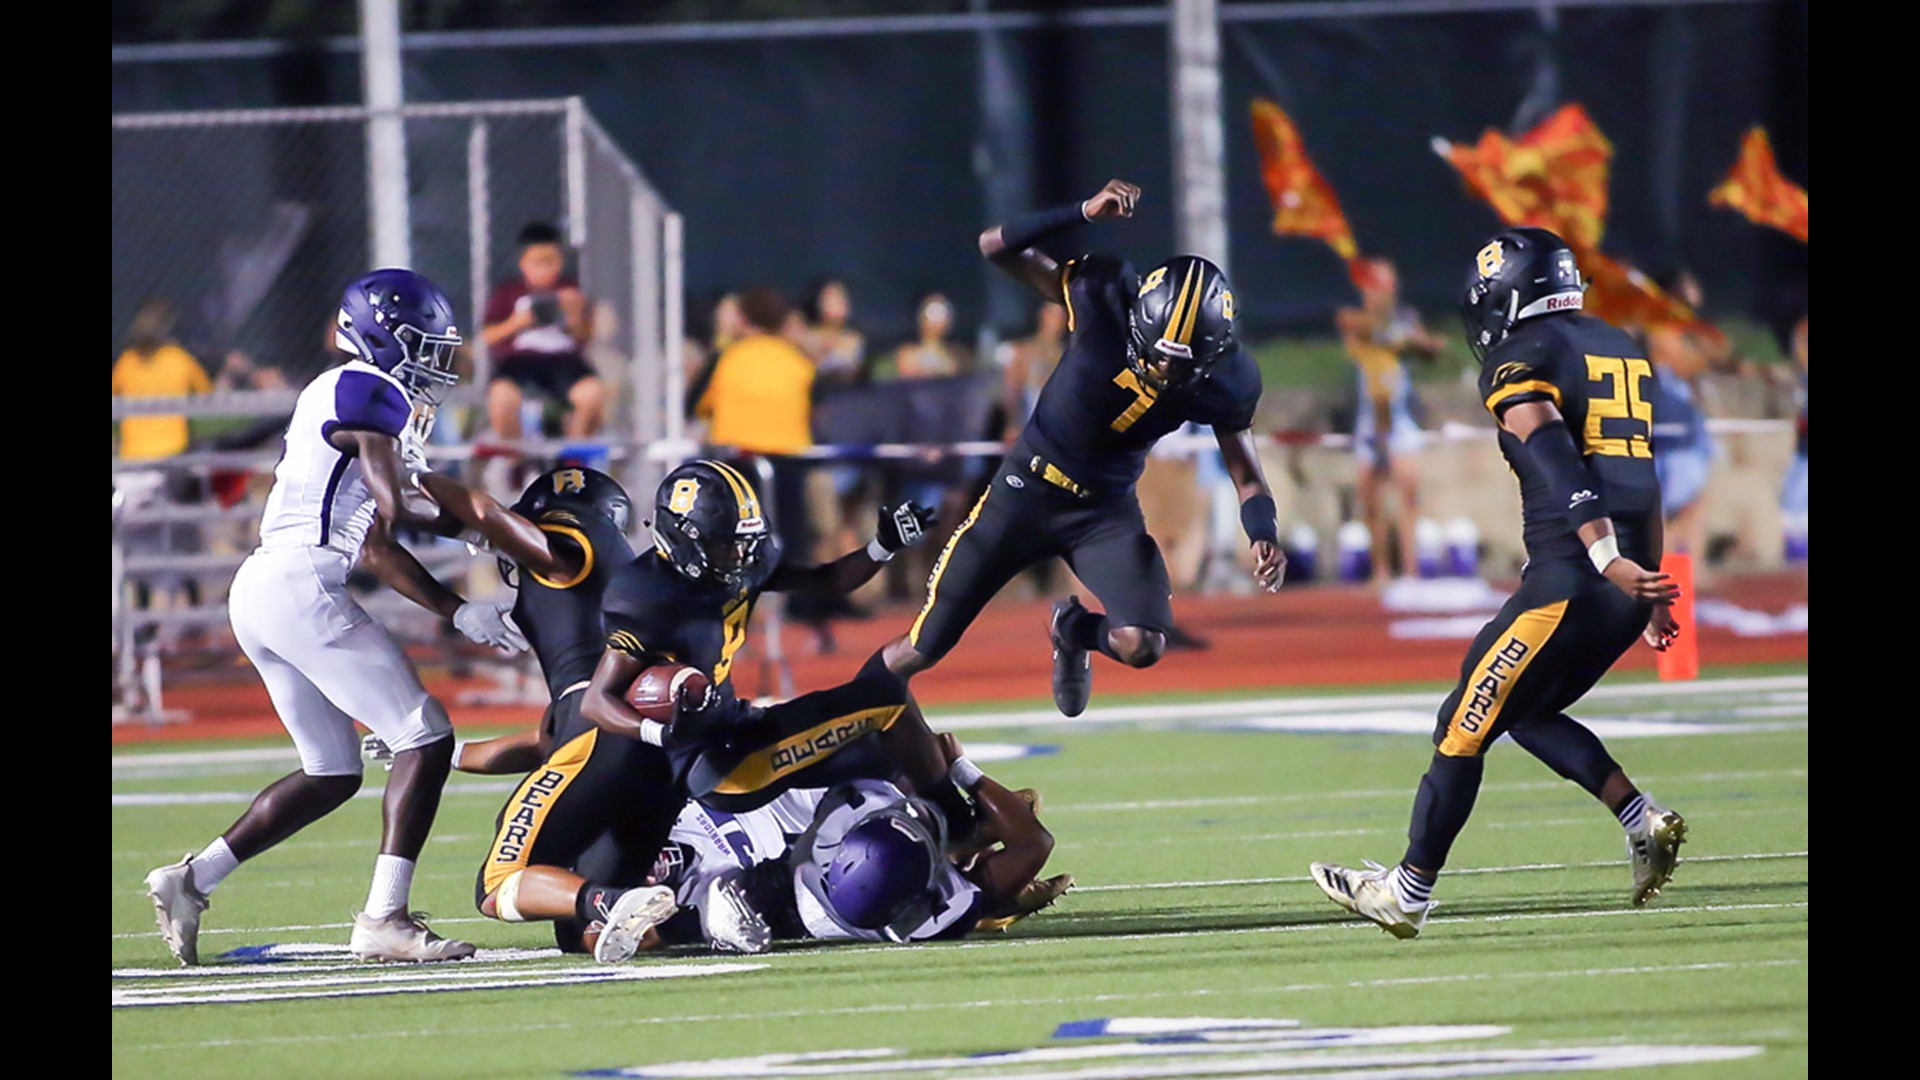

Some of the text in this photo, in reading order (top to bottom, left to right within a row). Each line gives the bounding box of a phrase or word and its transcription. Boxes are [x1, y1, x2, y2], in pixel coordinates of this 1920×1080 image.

[1109, 367, 1159, 433] 7
[1583, 354, 1652, 459] 25
[1460, 637, 1530, 734] BEARS
[770, 716, 876, 772] BEARS
[496, 770, 565, 863] BEARS
